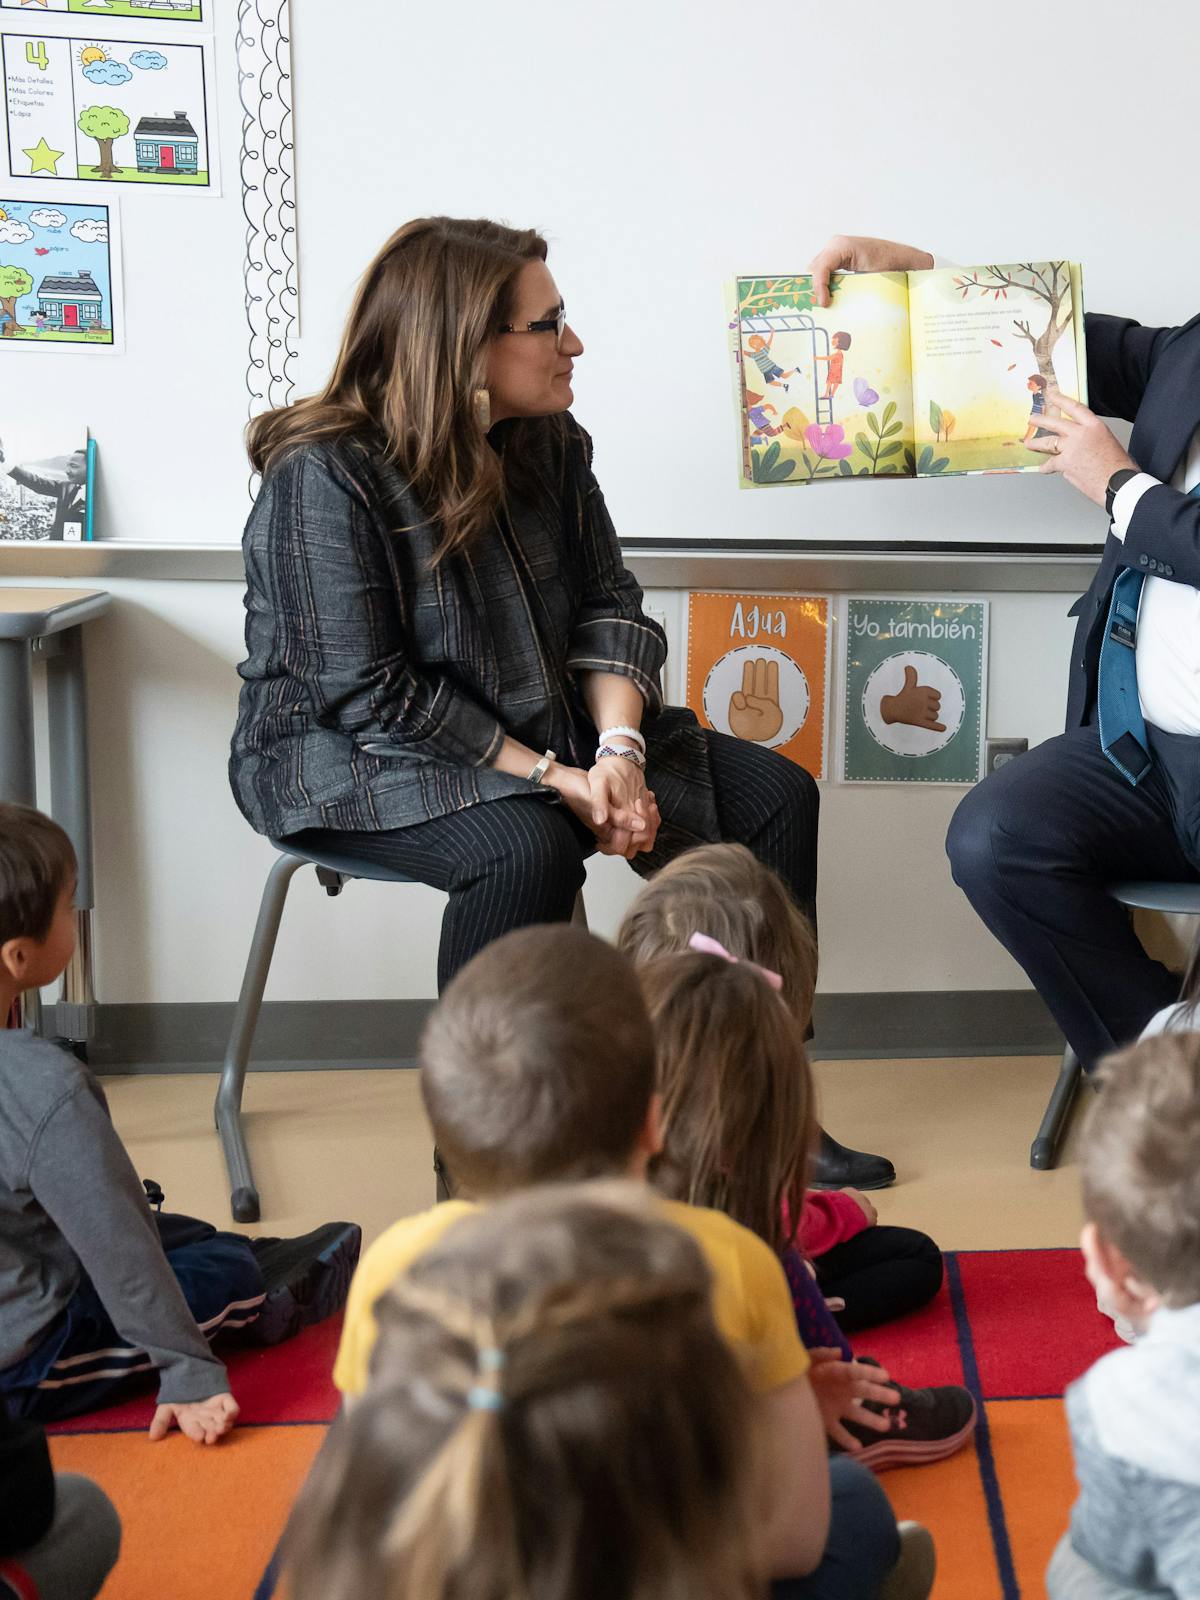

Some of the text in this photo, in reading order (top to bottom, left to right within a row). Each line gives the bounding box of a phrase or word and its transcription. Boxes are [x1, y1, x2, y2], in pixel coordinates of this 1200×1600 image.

[25, 41, 50, 71] 4
[730, 601, 787, 640] Agua
[854, 614, 976, 641] Yo también
